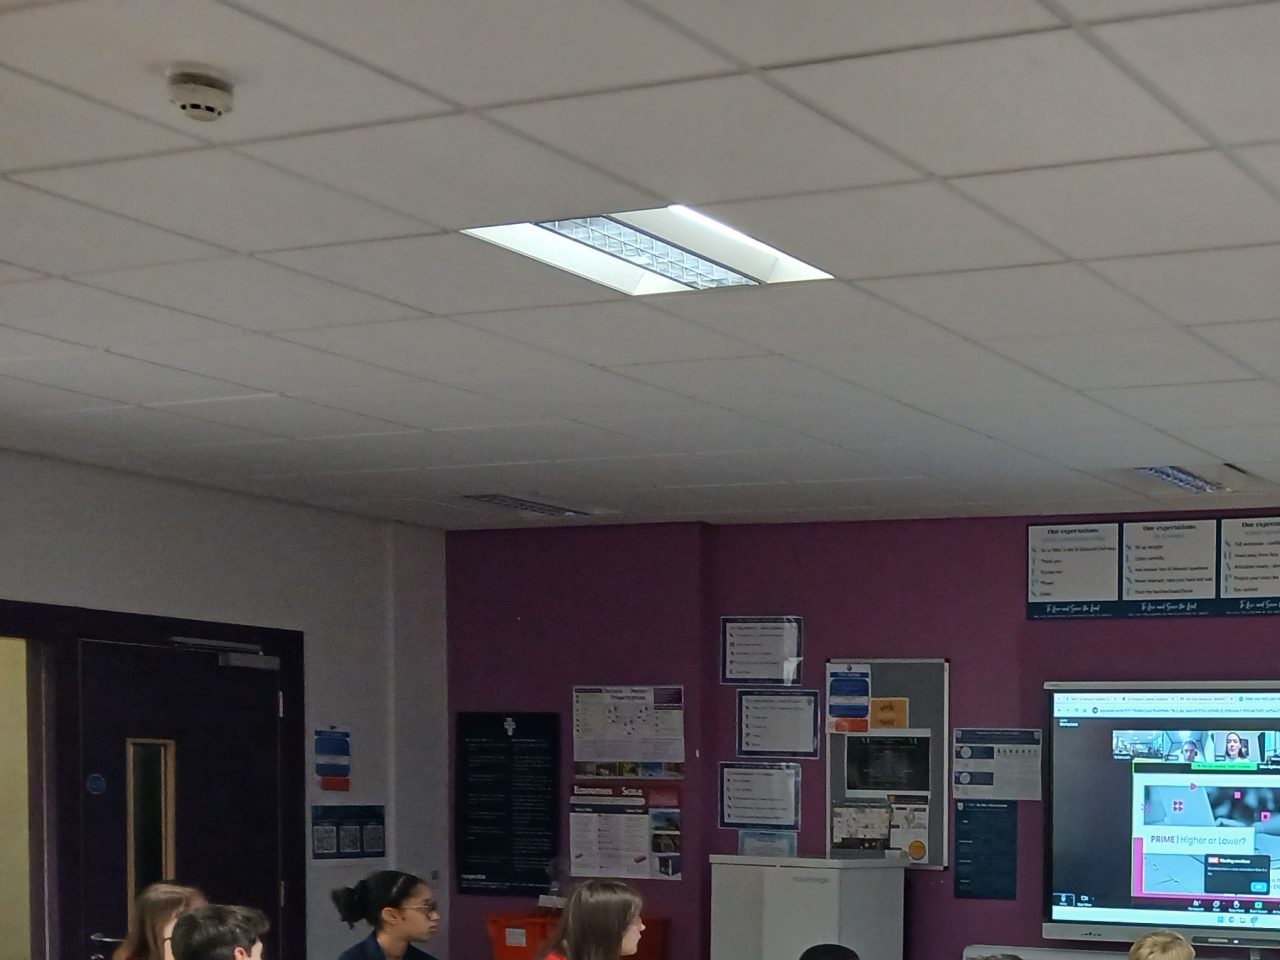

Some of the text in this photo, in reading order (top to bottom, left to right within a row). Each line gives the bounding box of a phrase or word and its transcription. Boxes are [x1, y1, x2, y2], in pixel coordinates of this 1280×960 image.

[1150, 835, 1175, 844] PRIME
[1180, 836, 1206, 846] Higher
[1218, 837, 1247, 846] Lower?
